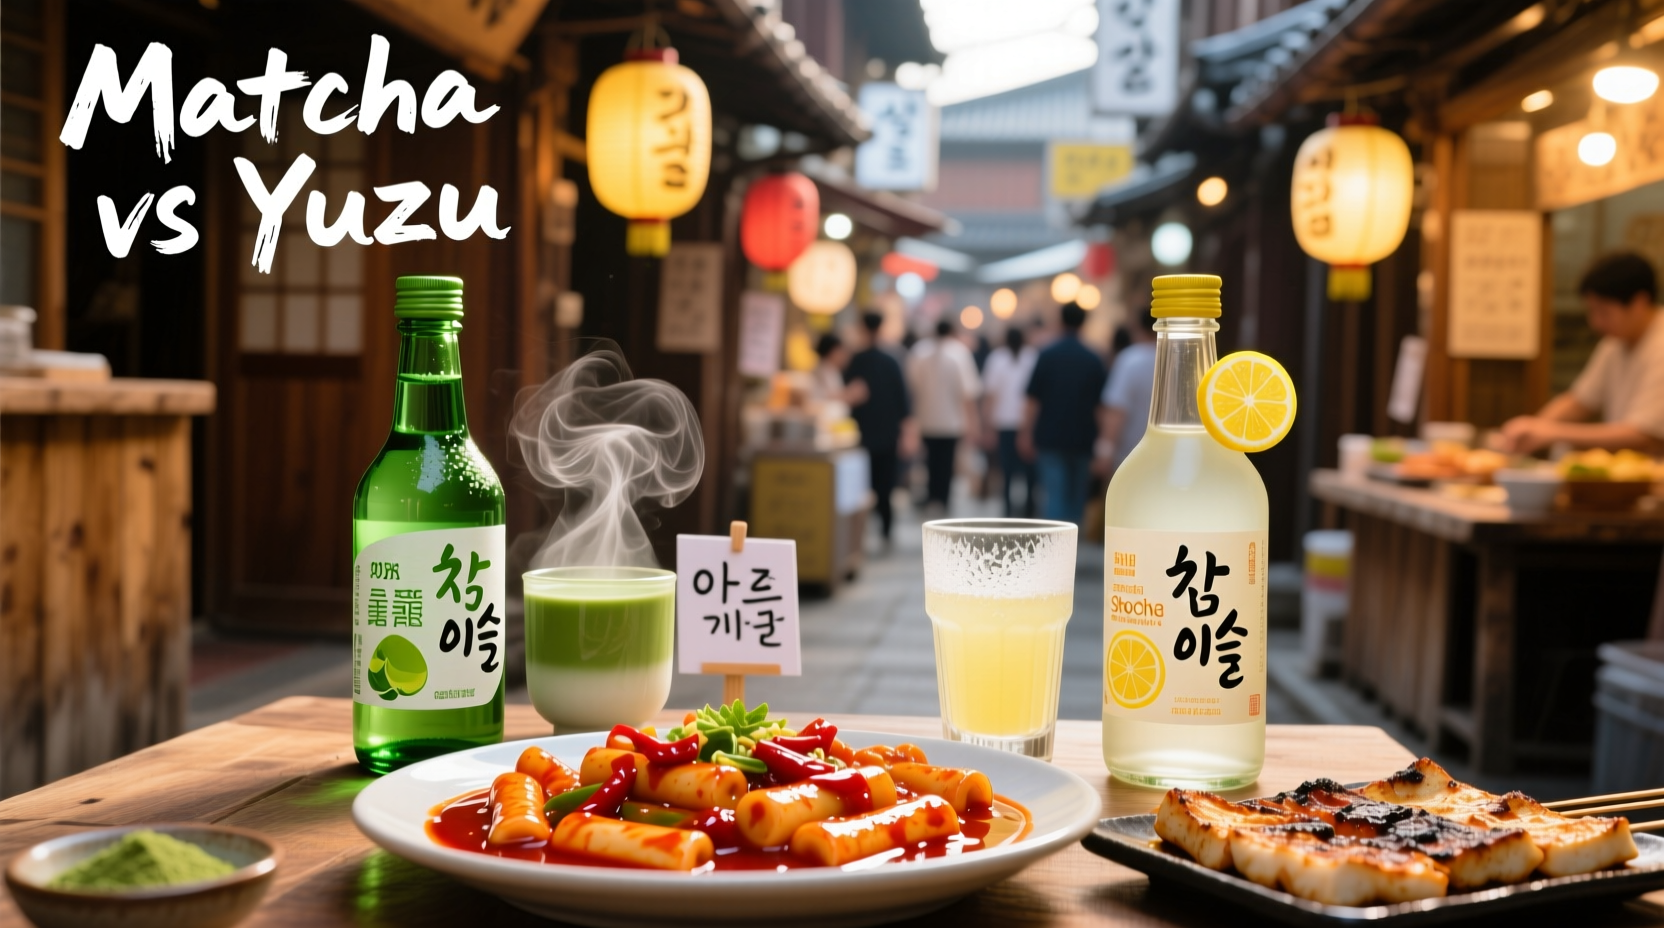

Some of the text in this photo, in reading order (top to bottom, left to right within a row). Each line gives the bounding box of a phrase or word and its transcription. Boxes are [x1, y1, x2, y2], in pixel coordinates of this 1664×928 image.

[1165, 544, 1230, 618] 참
[439, 602, 501, 673] 이슬
[1173, 608, 1248, 689] 이슬
